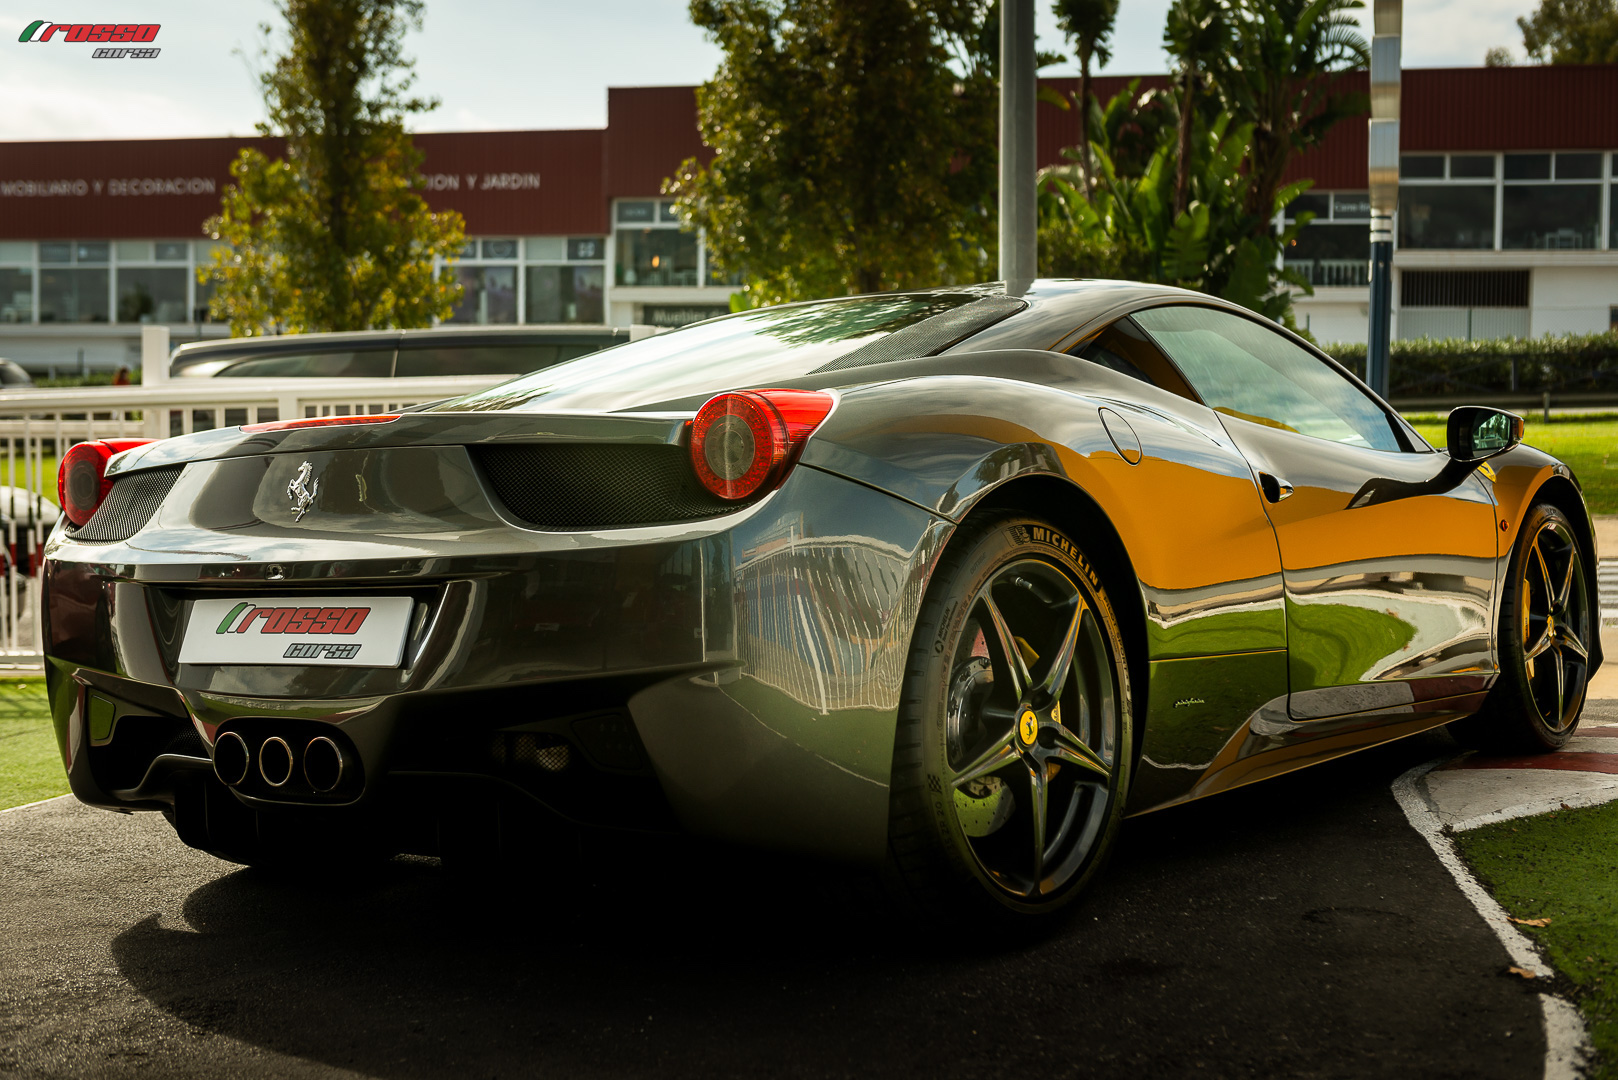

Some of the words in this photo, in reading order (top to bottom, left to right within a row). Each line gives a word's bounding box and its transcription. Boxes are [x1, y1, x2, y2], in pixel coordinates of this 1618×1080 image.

[0, 179, 88, 197] MOBILIARIO
[92, 179, 104, 196] Y
[107, 178, 216, 196] DECORACION
[465, 173, 478, 190] Y
[480, 172, 541, 190] JARDIN
[1033, 527, 1099, 586] MICHELIN
[938, 607, 951, 638] MICHELIN
[283, 643, 362, 659] corsa
